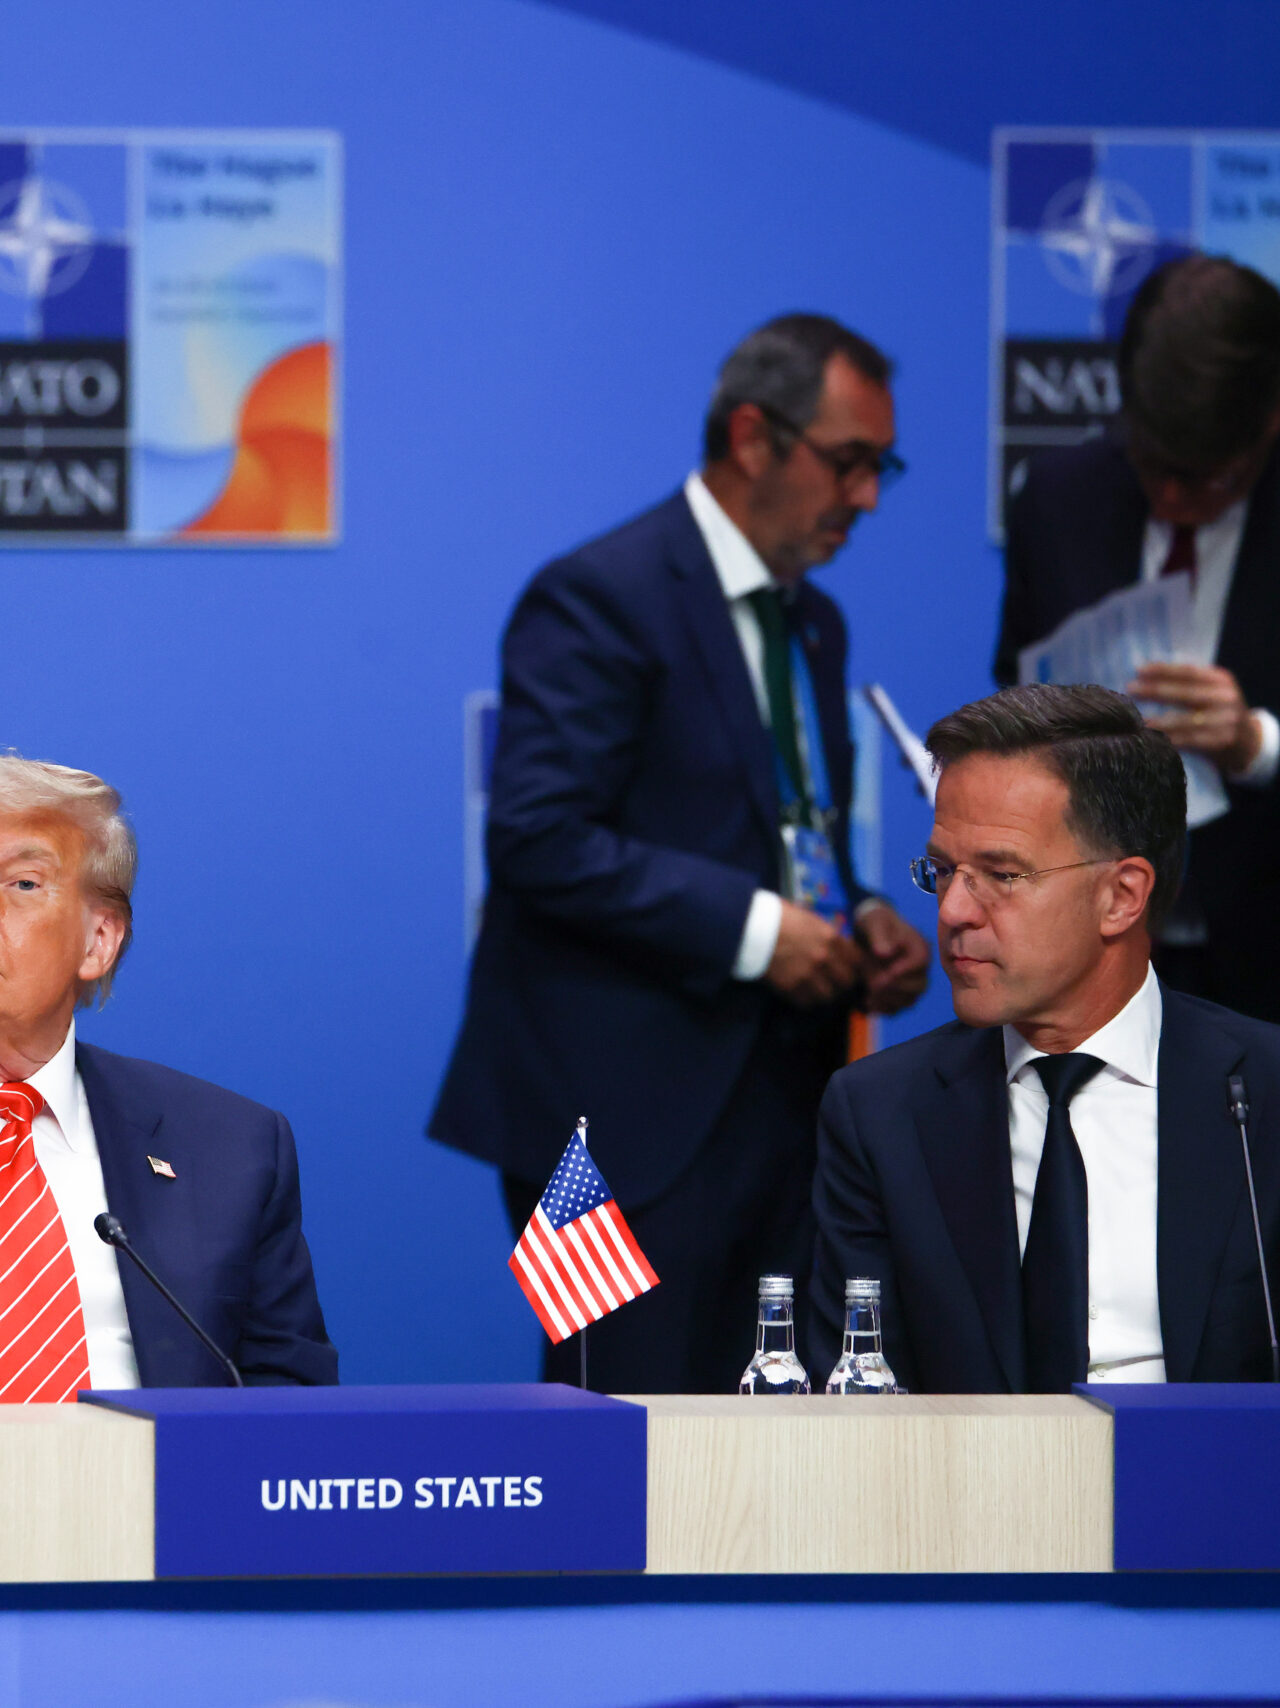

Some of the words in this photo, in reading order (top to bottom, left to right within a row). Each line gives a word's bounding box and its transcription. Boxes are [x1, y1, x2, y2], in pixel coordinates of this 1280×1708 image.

[1014, 359, 1121, 414] NAT
[261, 1478, 404, 1511] UNITED
[414, 1476, 543, 1508] STATES
